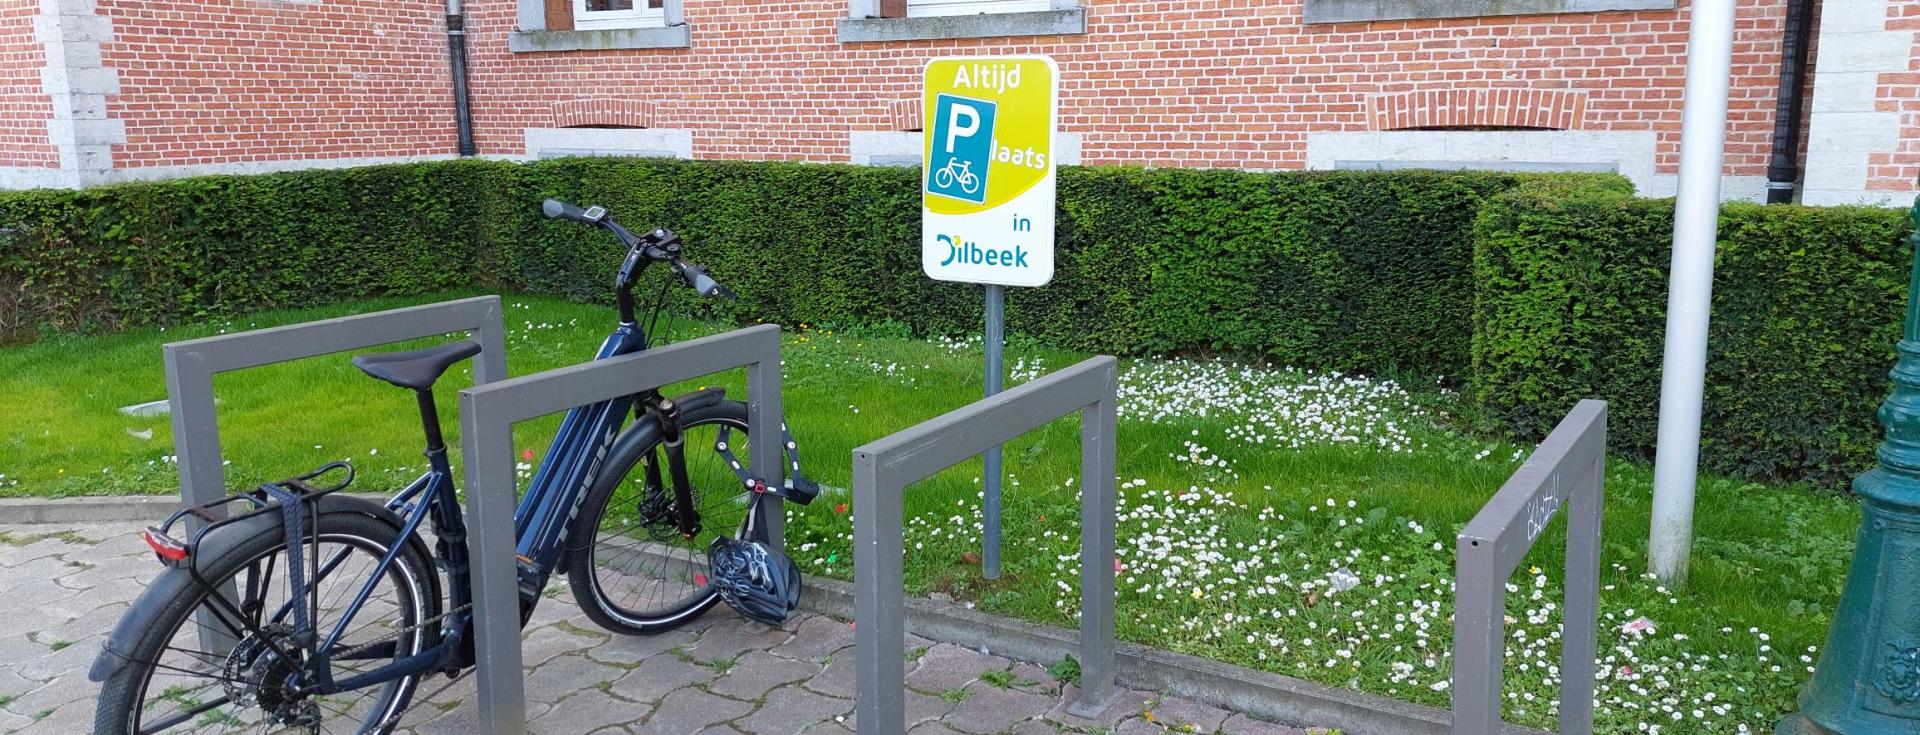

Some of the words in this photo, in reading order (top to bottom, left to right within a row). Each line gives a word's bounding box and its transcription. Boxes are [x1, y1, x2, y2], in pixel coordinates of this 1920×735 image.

[952, 63, 1021, 94] Altijd
[945, 102, 981, 154] P
[992, 139, 1046, 170] laats
[1013, 213, 1031, 232] in
[936, 233, 1029, 268] Dilbeek
[553, 424, 617, 549] TREK
